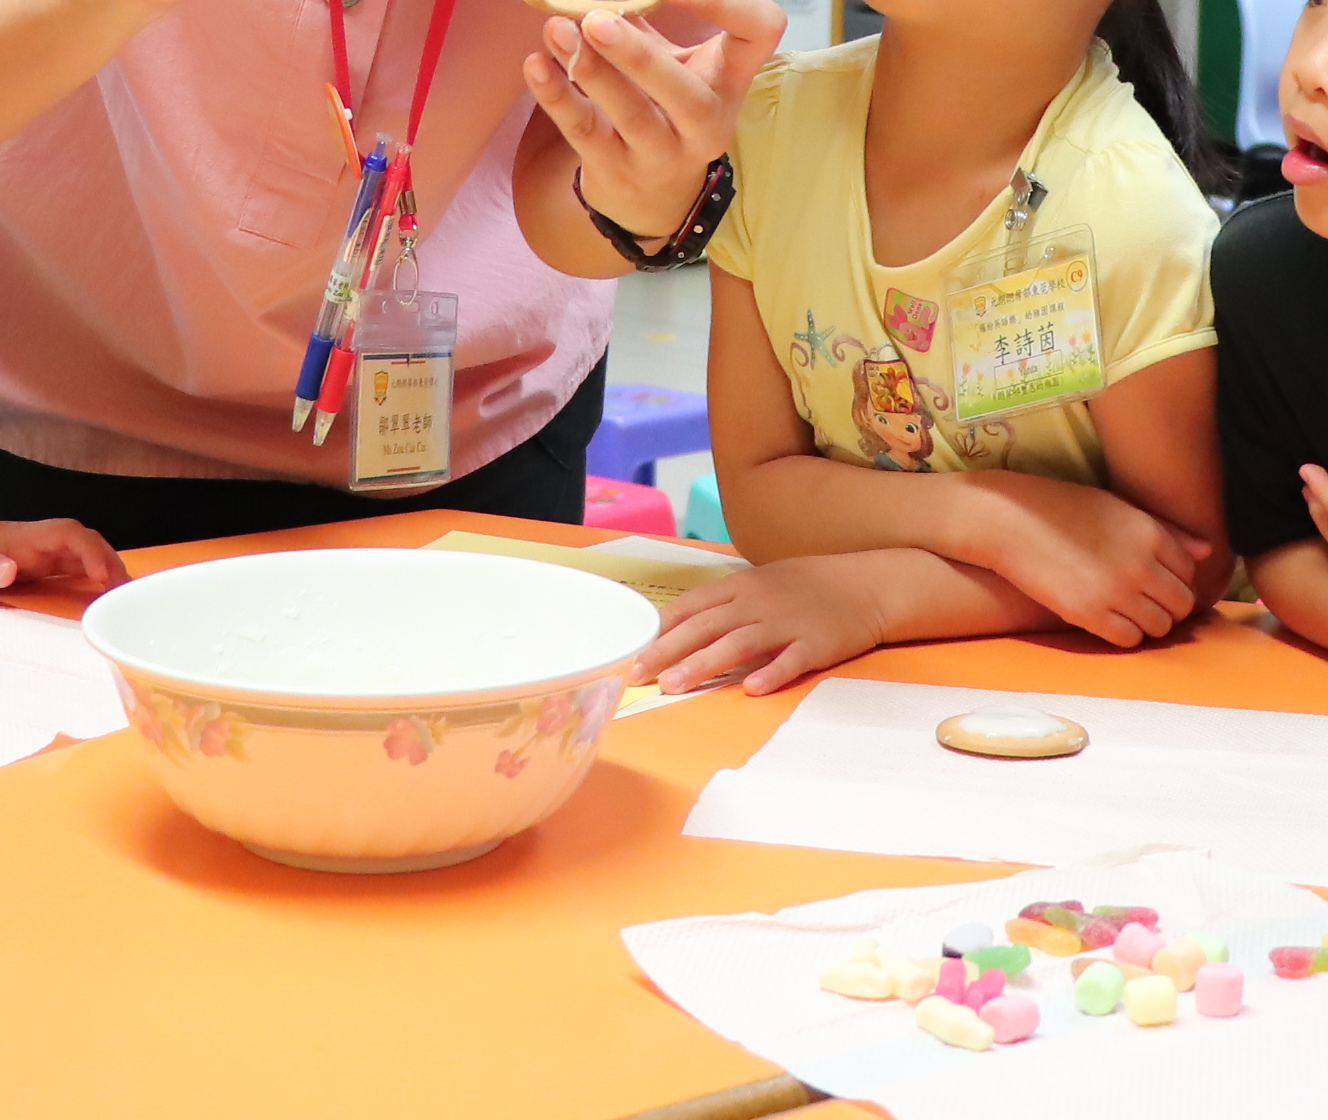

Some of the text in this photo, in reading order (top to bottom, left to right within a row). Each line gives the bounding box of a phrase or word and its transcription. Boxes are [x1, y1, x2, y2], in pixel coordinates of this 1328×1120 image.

[1070, 269, 1083, 284] C9
[994, 321, 1056, 365] 李詩茵
